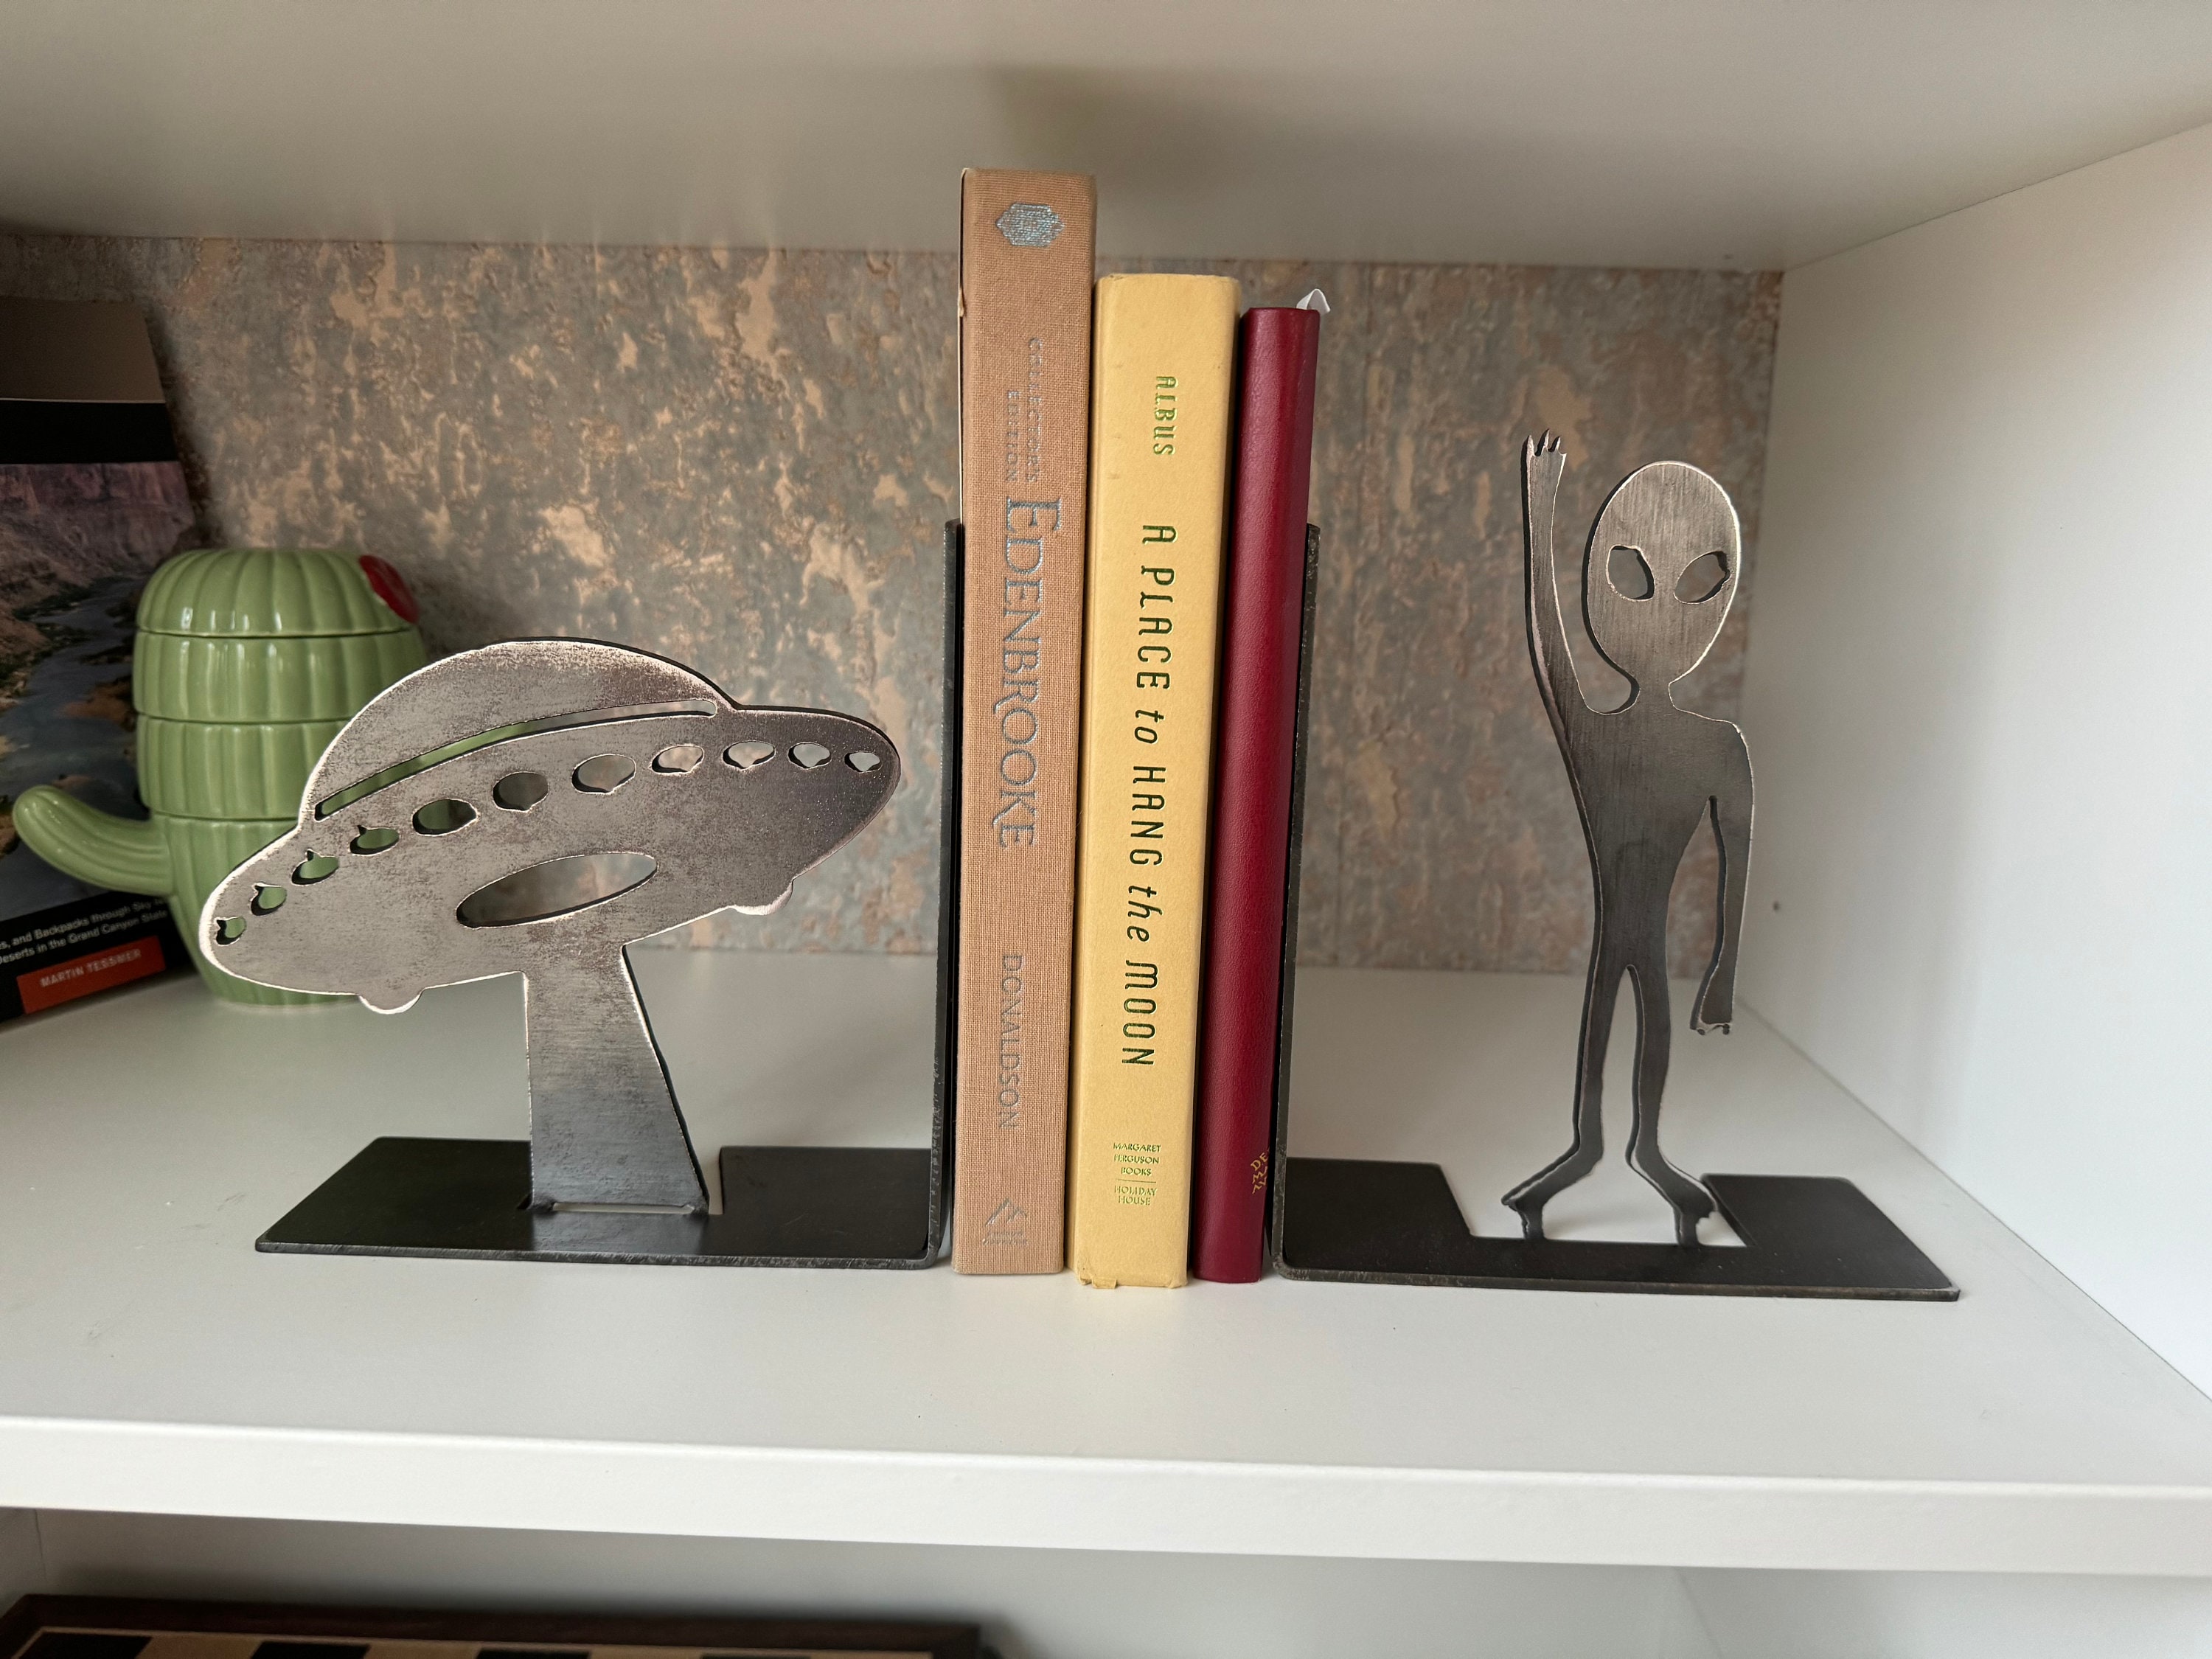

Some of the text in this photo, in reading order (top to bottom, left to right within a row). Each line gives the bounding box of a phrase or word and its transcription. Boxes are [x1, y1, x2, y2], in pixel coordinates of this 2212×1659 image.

[1027, 338, 1043, 481] COLLECTOR'S
[1152, 376, 1178, 455] ALBUS
[1006, 391, 1020, 481] EDITION
[1142, 524, 1178, 544] A
[1136, 566, 1175, 689] PLACE
[992, 497, 1062, 849] EDENBROOKE
[1133, 709, 1164, 744] to
[1129, 765, 1166, 866] HANG
[11, 932, 32, 946] and
[34, 917, 89, 939] Backpacks
[90, 905, 131, 922] through
[38, 944, 47, 953] in
[47, 939, 66, 950] the
[67, 928, 100, 944] Grand
[101, 917, 139, 933] Canyon
[141, 910, 168, 922] State
[1127, 886, 1163, 943] the
[39, 948, 142, 988] MARTIN TESSMER
[998, 955, 1023, 1129] DONALDSON
[1113, 1143, 1161, 1152] MARGARET
[1114, 1154, 1159, 1164] FERGUSON
[1114, 1185, 1157, 1197] HOLIDAY
[1121, 1166, 1152, 1176] BOOKS
[1118, 1195, 1151, 1206] HOUSE
